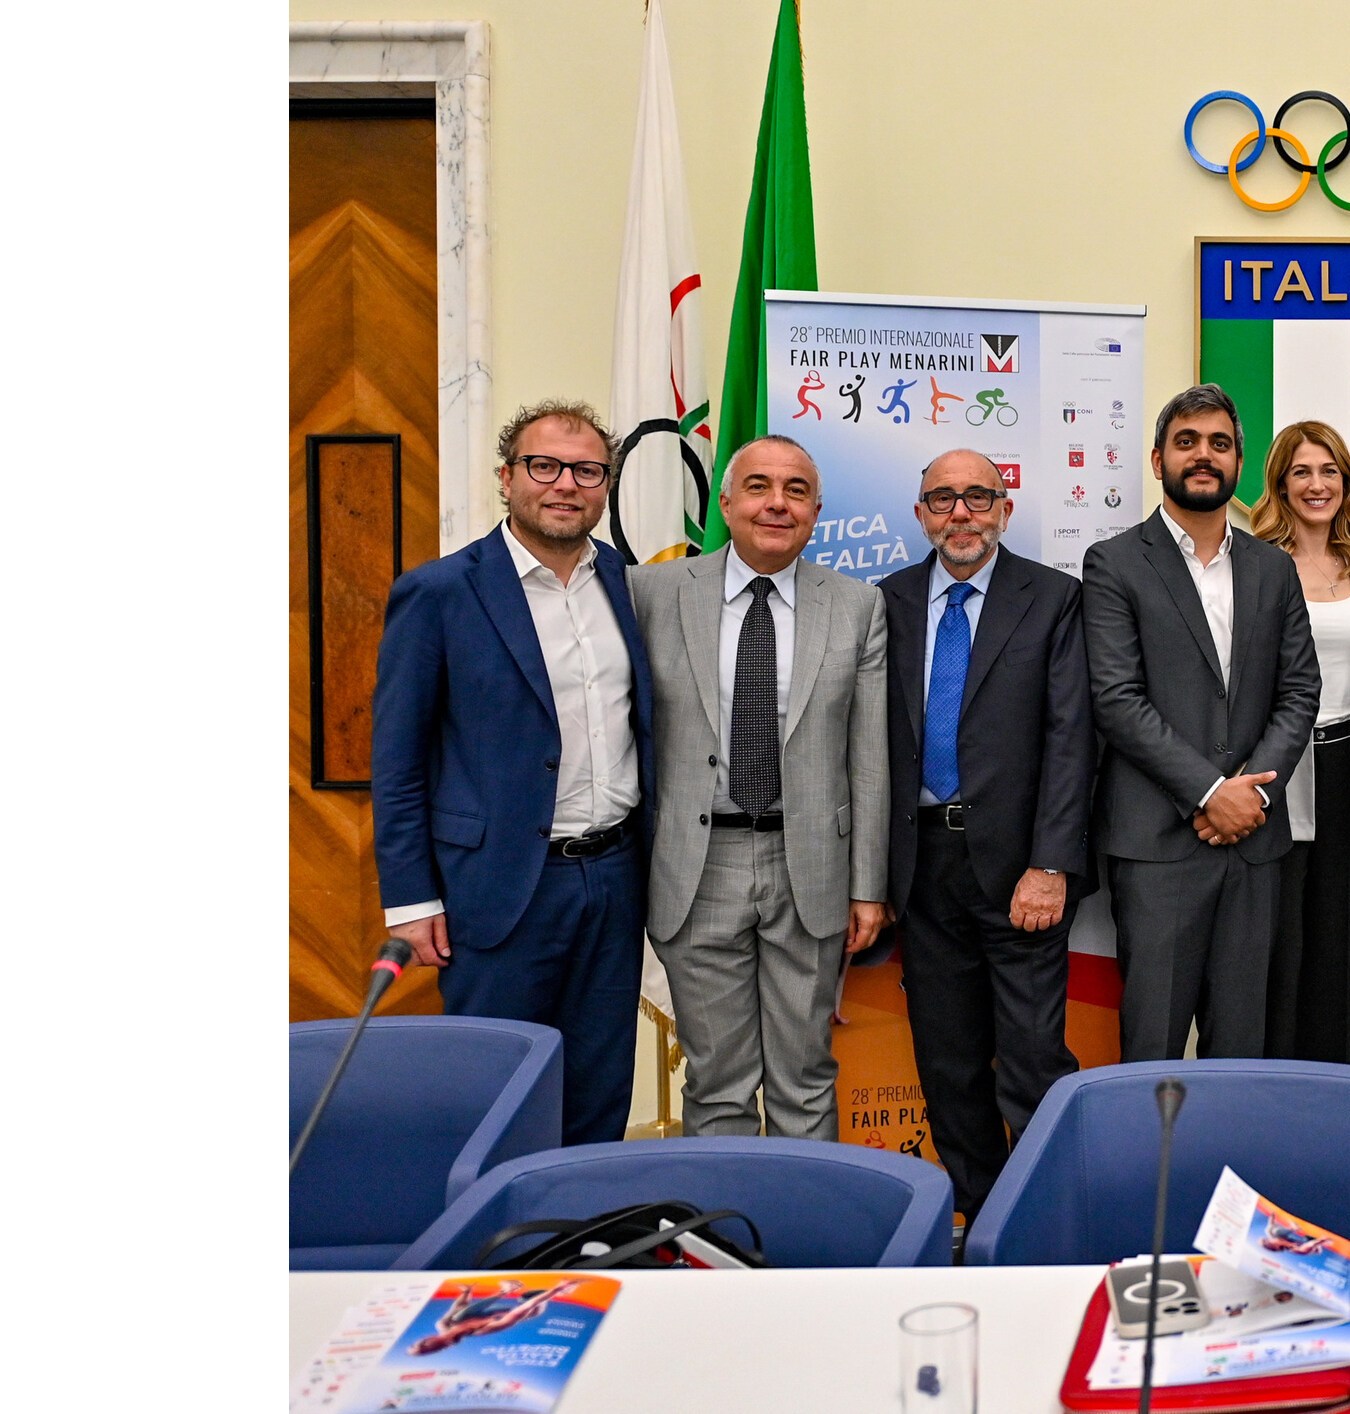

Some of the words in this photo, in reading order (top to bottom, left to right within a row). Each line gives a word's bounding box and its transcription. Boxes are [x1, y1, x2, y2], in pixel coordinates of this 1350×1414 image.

[790, 326, 812, 343] 28°
[816, 327, 866, 345] PREMIO
[870, 329, 974, 348] INTERNAZIONALE
[790, 349, 829, 367] FAIR
[839, 351, 881, 368] PLAY
[890, 353, 974, 371] MENARINI
[999, 468, 1016, 483] 4
[811, 536, 909, 571] EALTÀ
[851, 1087, 874, 1105] 28°
[878, 1085, 924, 1103] PREMIO
[852, 1110, 890, 1129] FAIR
[900, 1107, 930, 1125] PLA
